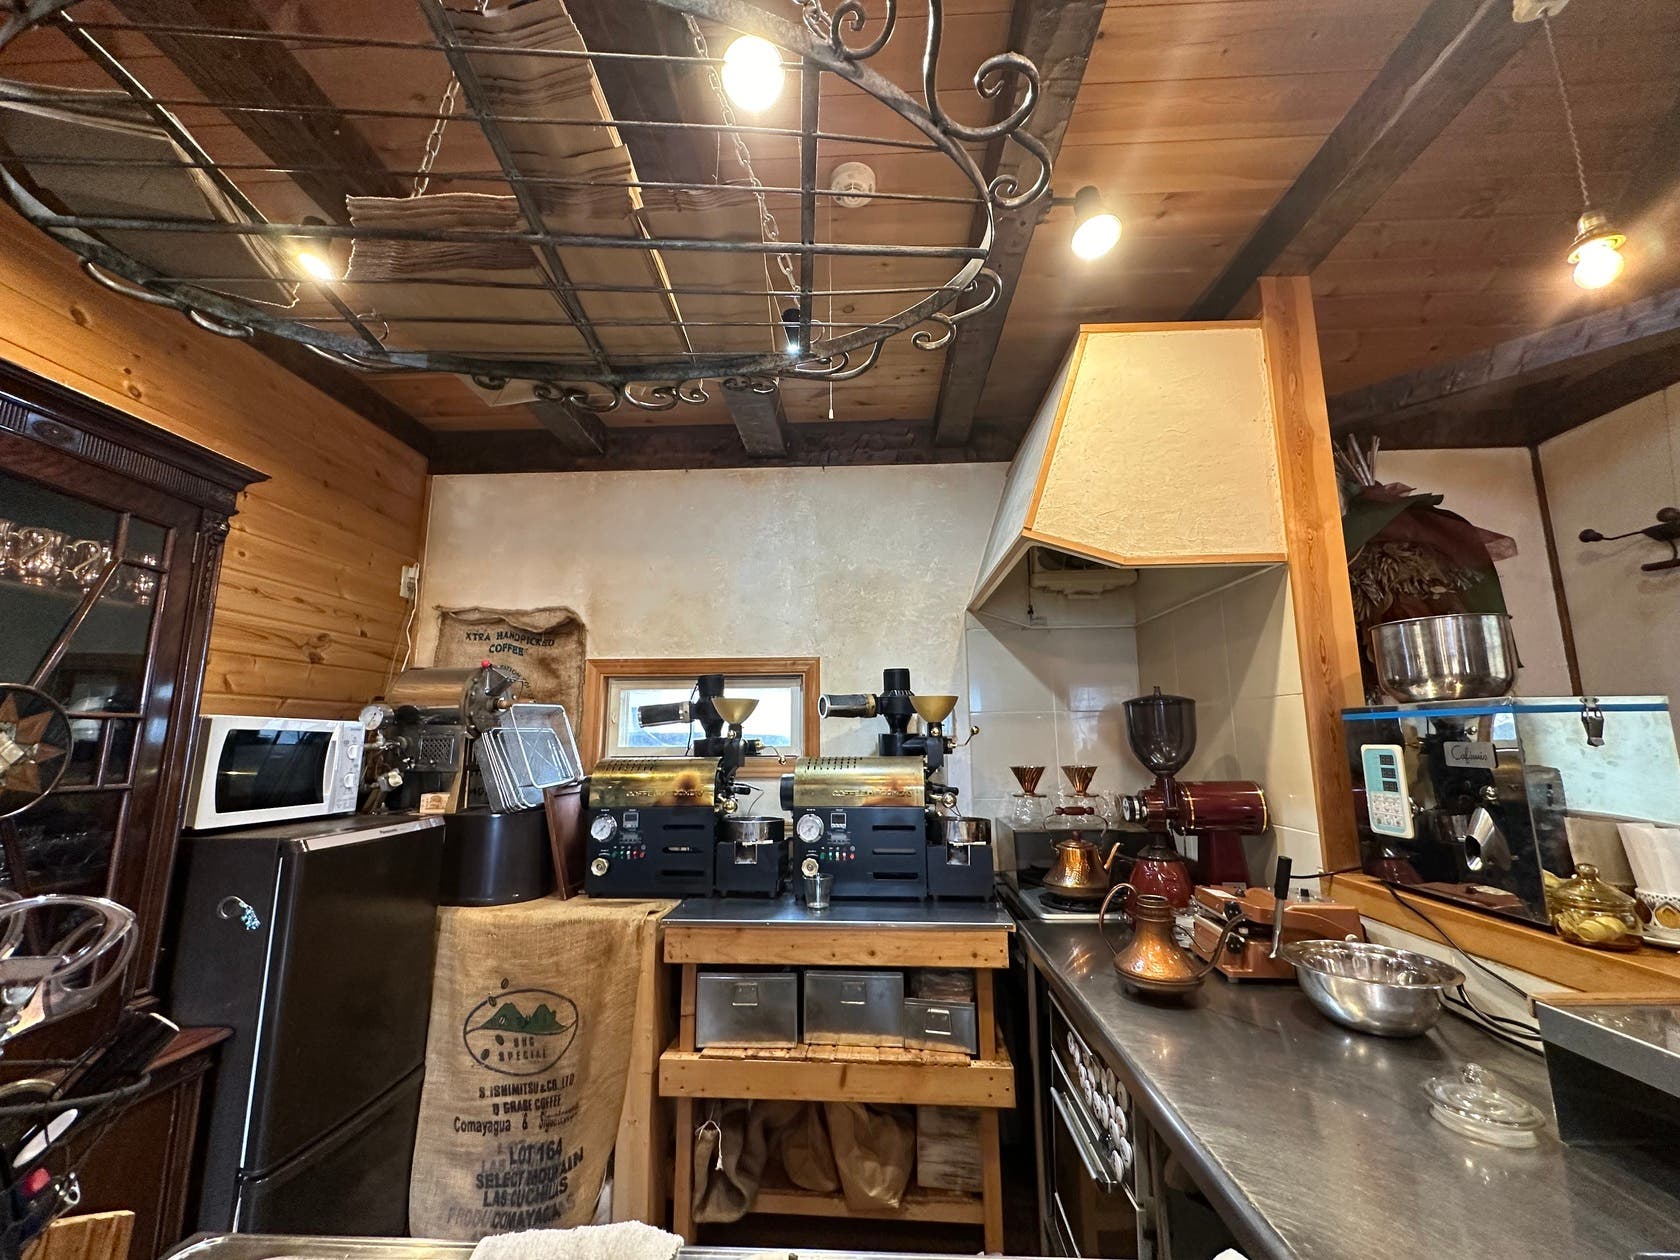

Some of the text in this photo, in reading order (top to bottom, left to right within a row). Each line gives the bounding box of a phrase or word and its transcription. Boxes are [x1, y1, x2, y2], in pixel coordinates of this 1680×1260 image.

[465, 631, 555, 647] XTRA HANDPICKED
[489, 643, 524, 656] COFFEE
[498, 1048, 546, 1061] SPECIAL
[535, 1094, 561, 1110] COFFEE
[454, 1116, 511, 1136] Comayagua
[510, 1144, 534, 1165] LOT
[476, 1170, 525, 1189] SELECT
[483, 1190, 507, 1207] LAS
